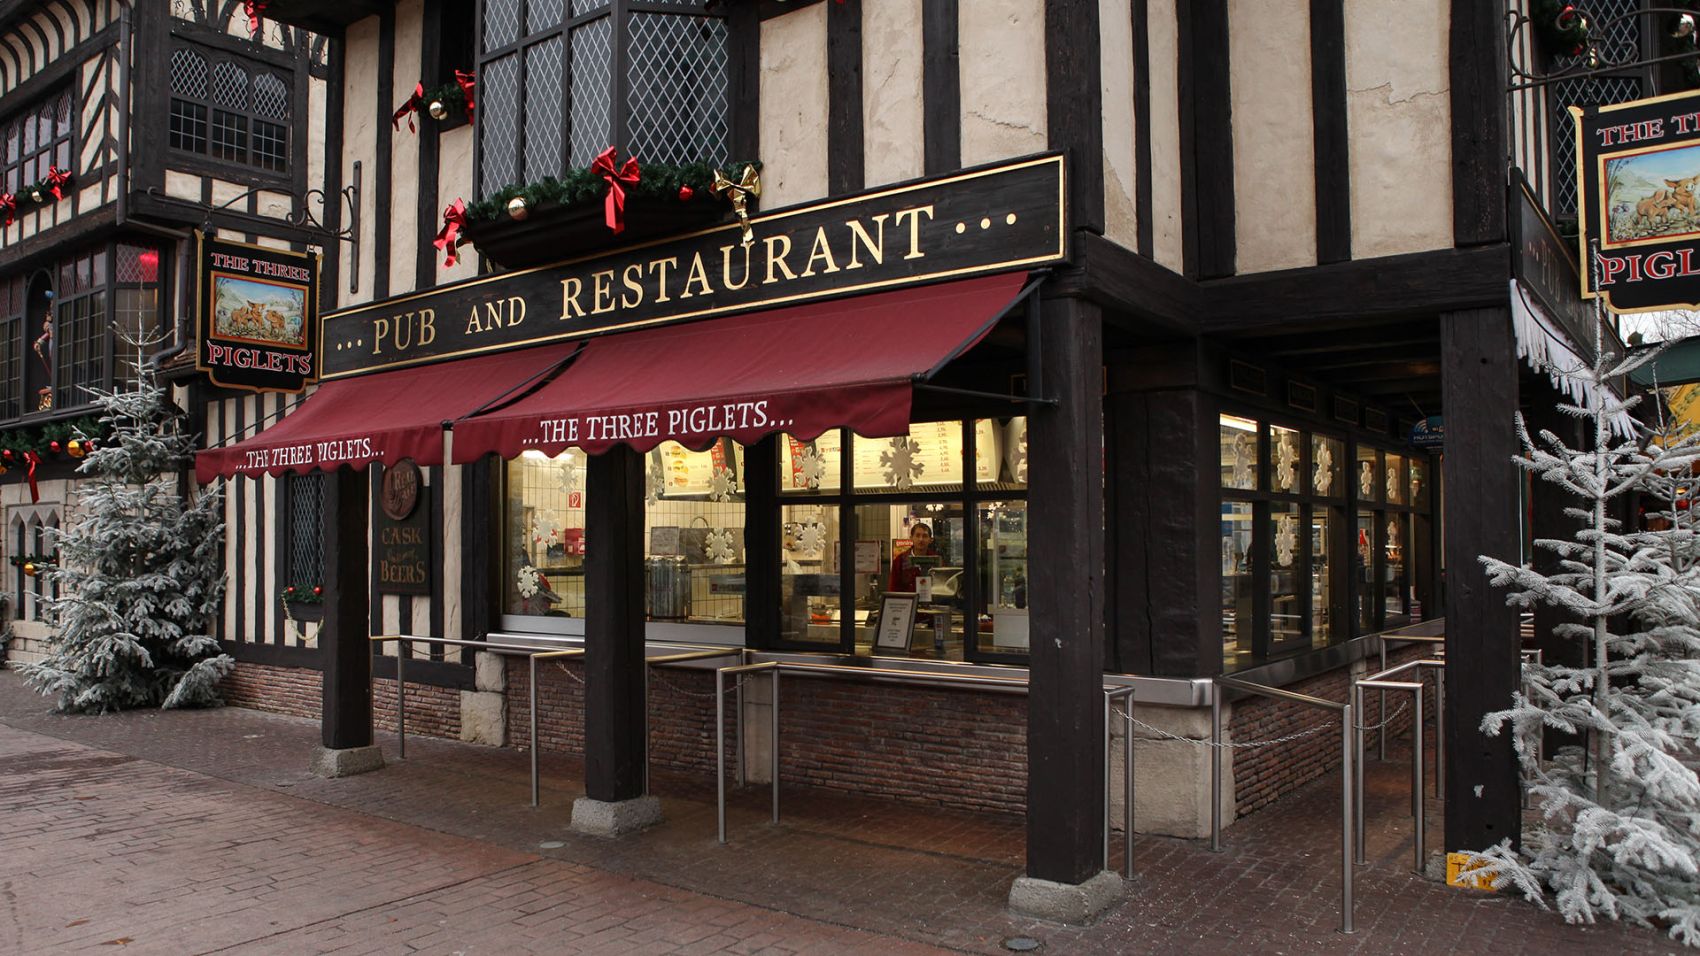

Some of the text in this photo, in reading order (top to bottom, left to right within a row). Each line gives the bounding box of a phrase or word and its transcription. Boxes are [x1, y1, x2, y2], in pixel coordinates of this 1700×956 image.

[1596, 110, 1700, 147] THE T
[211, 252, 310, 282] THE THREE
[465, 296, 526, 335] AND
[207, 340, 312, 375] PIGLETS
[586, 412, 659, 440] THREE
[272, 444, 312, 467] THREE
[382, 527, 423, 545] CASK
[381, 560, 426, 584] BEERS
